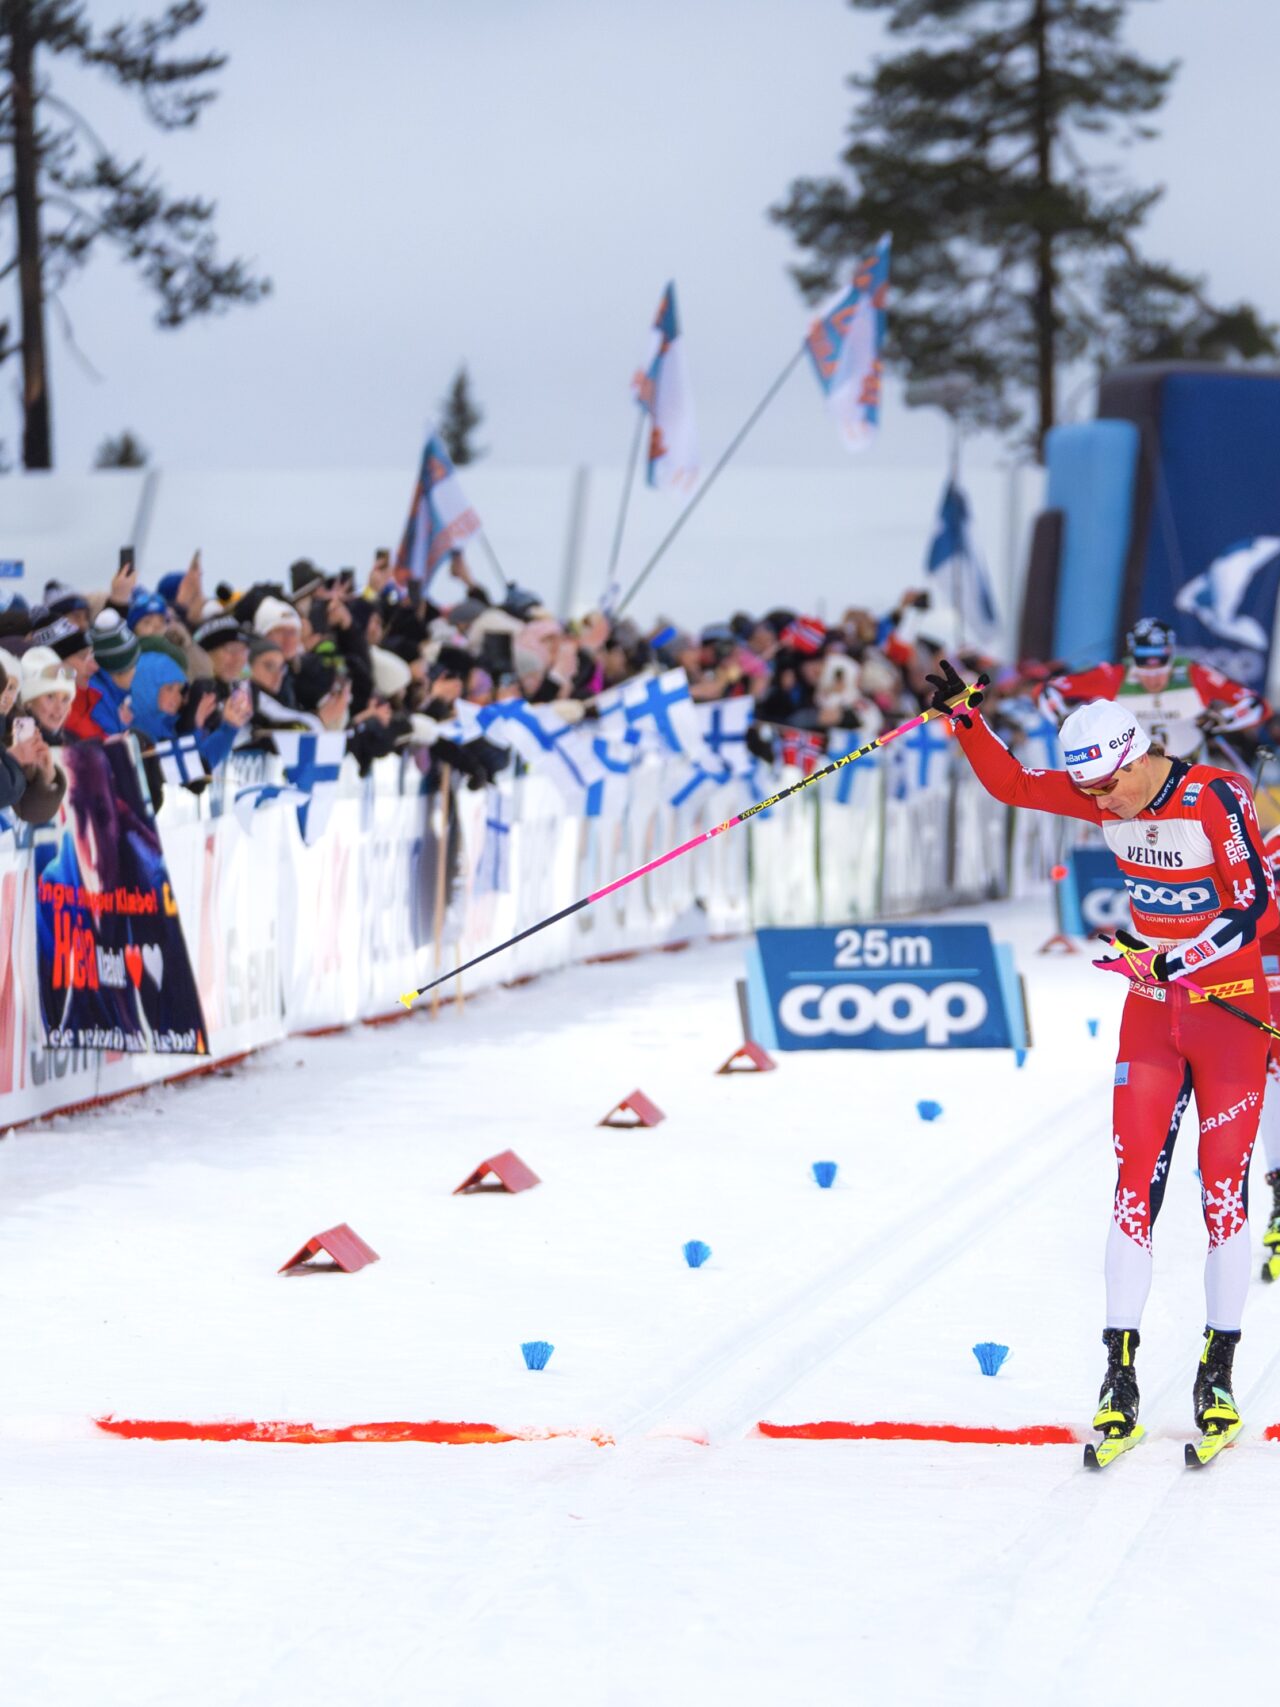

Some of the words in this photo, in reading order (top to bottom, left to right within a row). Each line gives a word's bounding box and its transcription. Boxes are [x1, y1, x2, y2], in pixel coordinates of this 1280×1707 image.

[1223, 840, 1241, 866] ADE
[1226, 813, 1250, 861] POWER
[1127, 846, 1183, 868] VELTINS
[1178, 914, 1206, 924] WORLD
[834, 930, 932, 968] 25m
[779, 982, 987, 1044] coop
[1200, 1098, 1247, 1133] CRAFT
